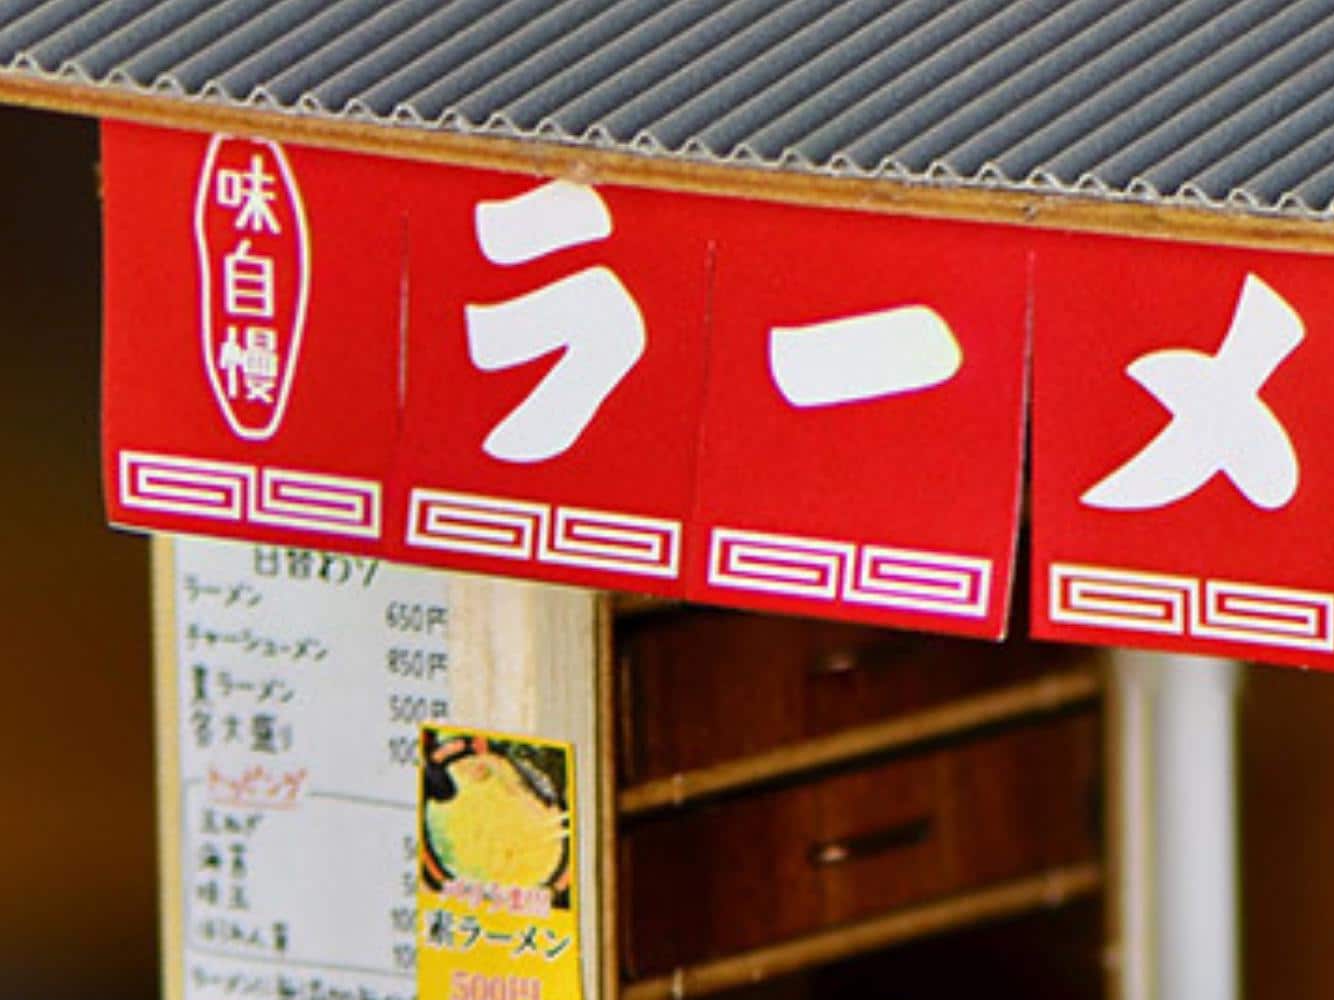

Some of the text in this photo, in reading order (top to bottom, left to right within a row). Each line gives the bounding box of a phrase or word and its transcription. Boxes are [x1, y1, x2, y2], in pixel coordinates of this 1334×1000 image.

[216, 155, 281, 402] 味自慢
[425, 910, 572, 959] 素ラーメン
